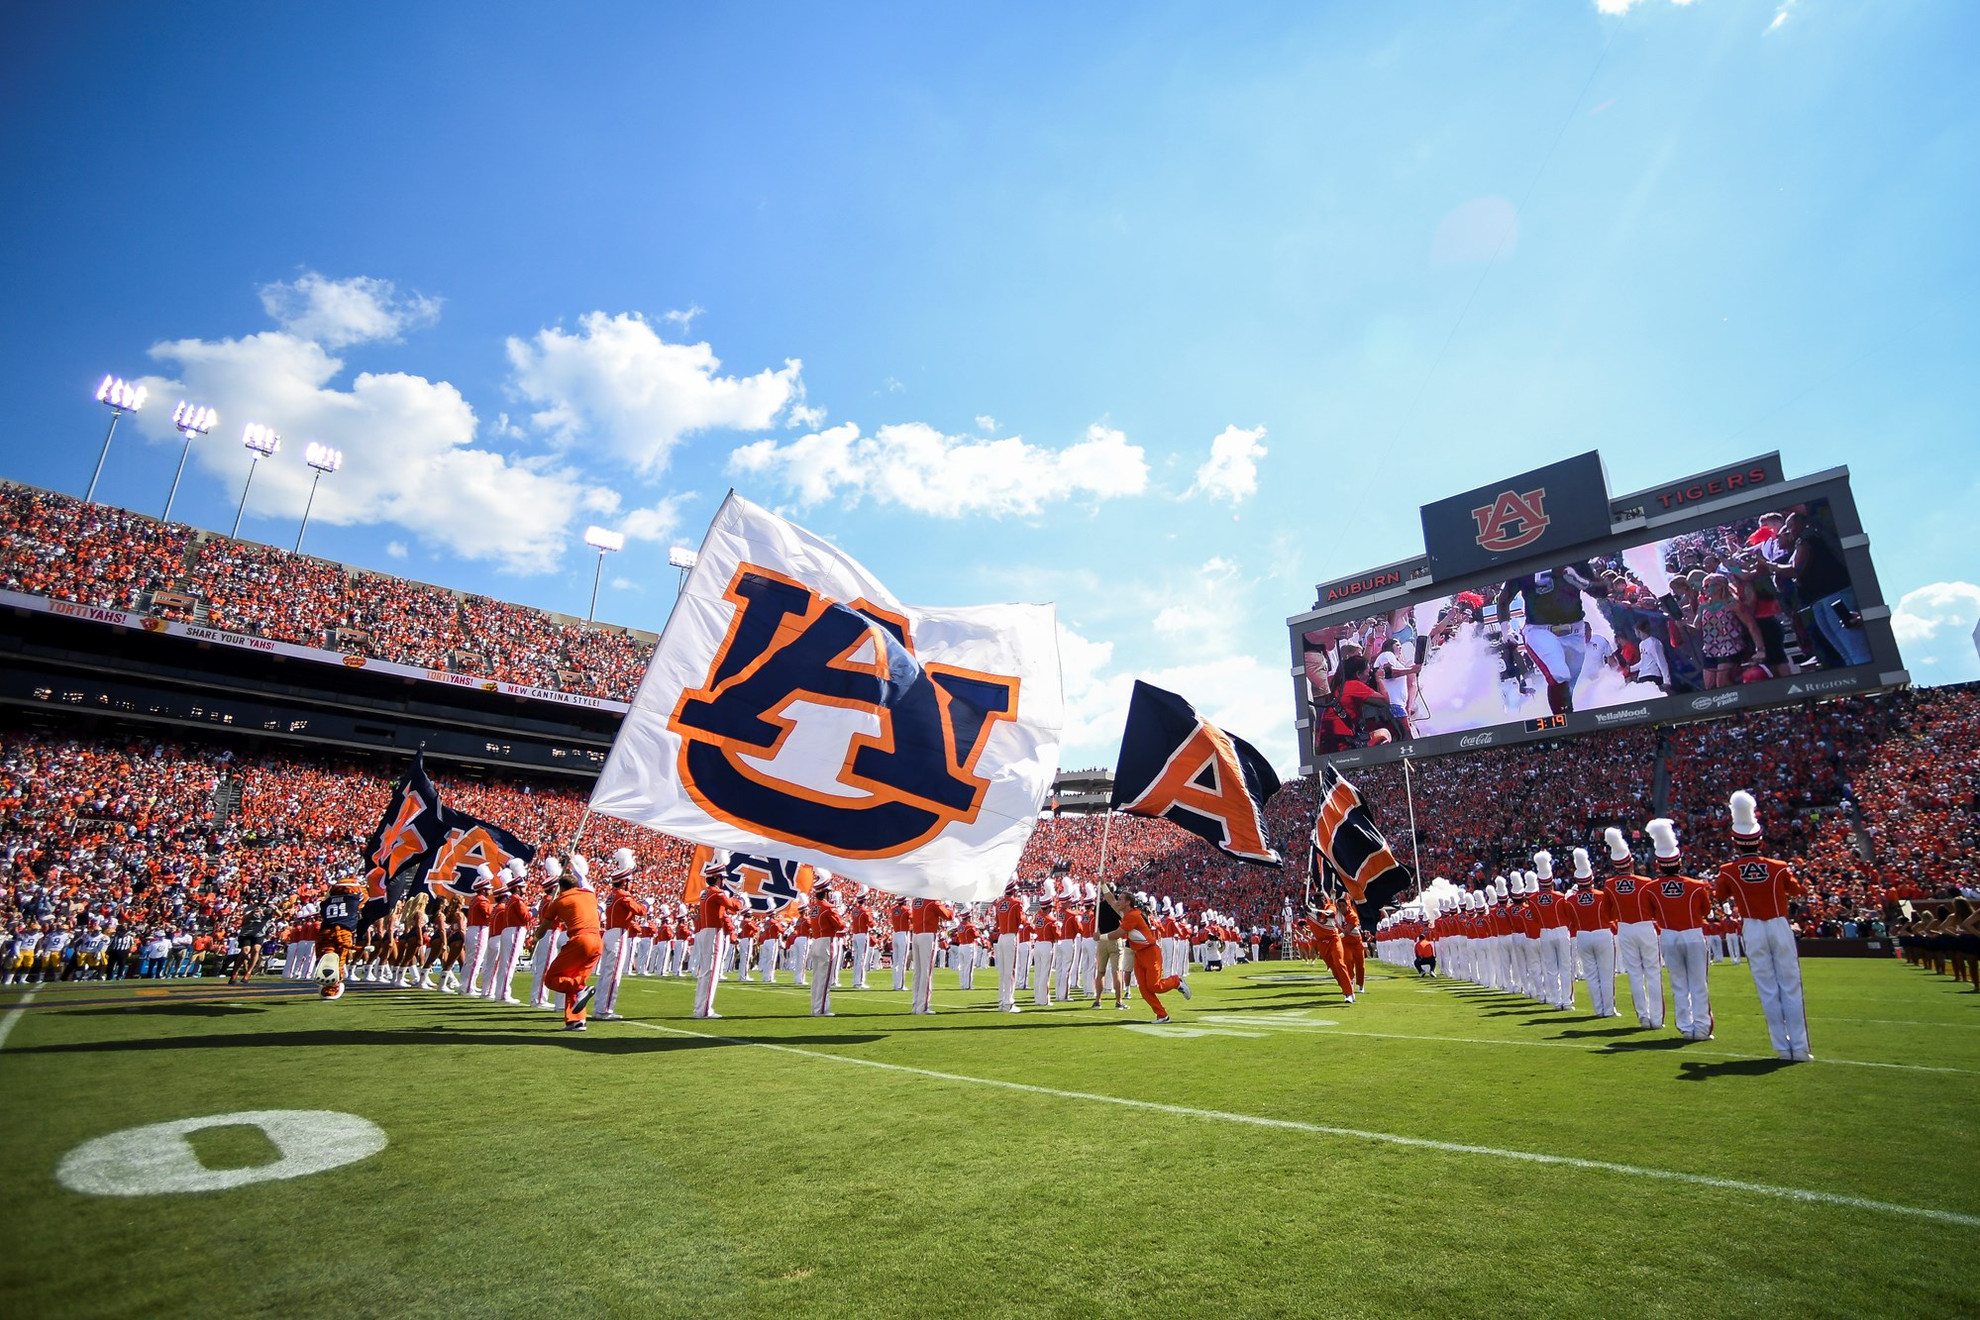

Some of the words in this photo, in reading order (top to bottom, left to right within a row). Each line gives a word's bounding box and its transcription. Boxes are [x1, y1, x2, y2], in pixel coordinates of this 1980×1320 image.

[1657, 468, 1766, 509] TIGERS
[1327, 571, 1399, 601] AUBURN
[48, 600, 127, 625] TORTIYAHS!
[186, 627, 218, 640] SHARE
[221, 633, 245, 645] YOUR
[426, 670, 474, 686] TORTIYAHS!
[507, 685, 528, 695] NEW
[531, 689, 569, 702] CANTINA
[573, 696, 600, 707] STYLE!
[1536, 714, 1566, 732] 3:19
[1595, 707, 1647, 721] YellaWood
